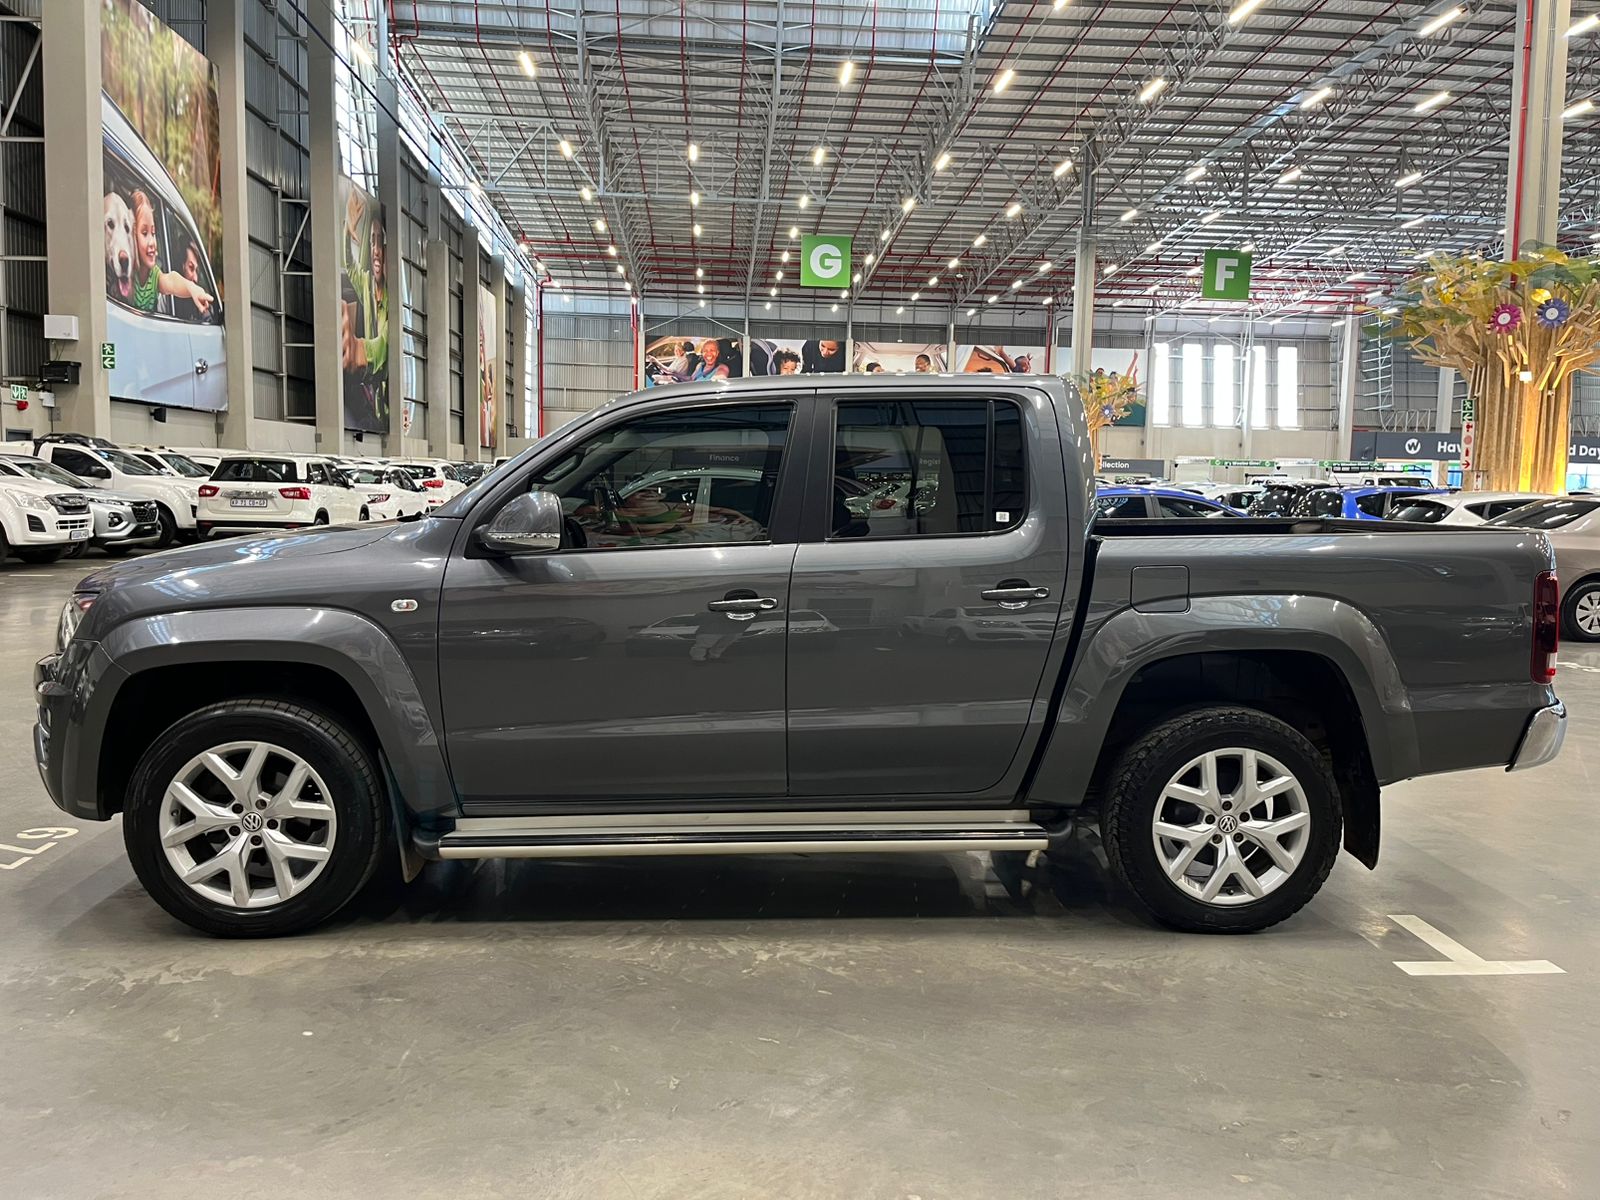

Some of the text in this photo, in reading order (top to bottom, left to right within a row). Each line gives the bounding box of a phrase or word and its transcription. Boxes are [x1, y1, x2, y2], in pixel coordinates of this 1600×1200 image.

[810, 244, 842, 278] G
[1215, 257, 1239, 291] F
[1102, 461, 1130, 469] llection
